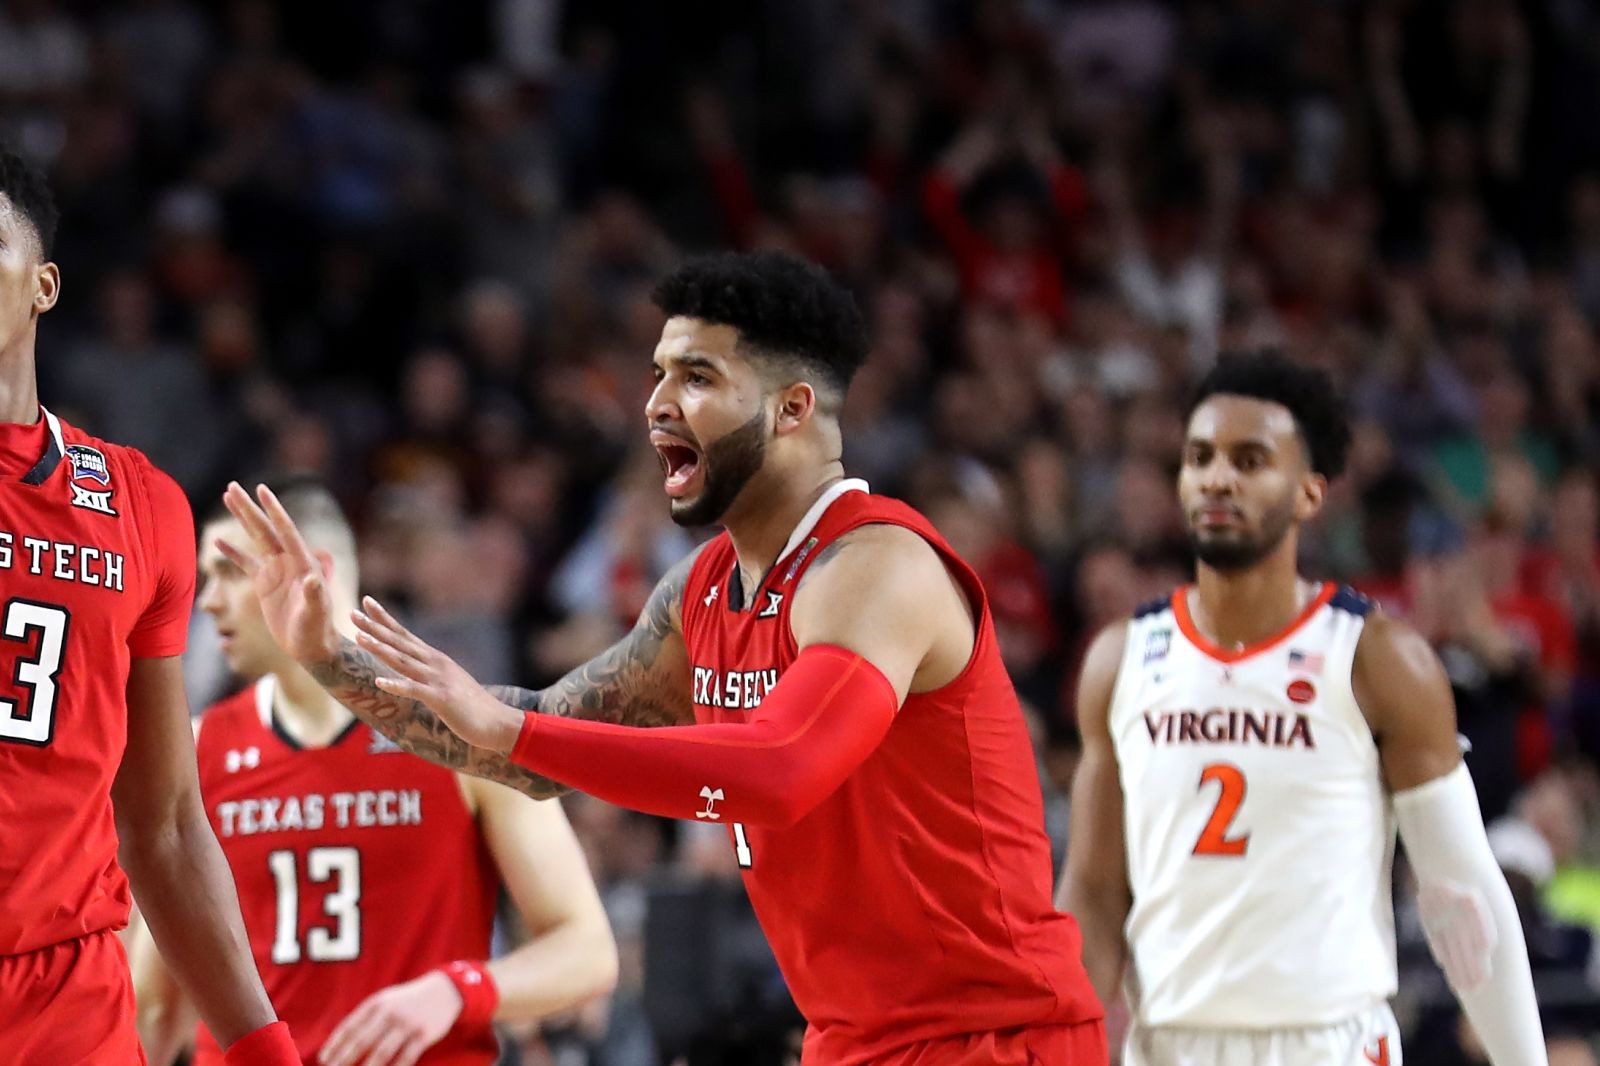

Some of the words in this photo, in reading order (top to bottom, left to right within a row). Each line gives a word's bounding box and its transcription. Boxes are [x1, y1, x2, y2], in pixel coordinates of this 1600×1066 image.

[75, 460, 104, 473] FOUR
[23, 535, 125, 592] TECH
[1143, 707, 1316, 750] VIRGINIA
[216, 793, 325, 838] TEXAS
[330, 788, 423, 828] TECH
[1191, 761, 1251, 857] 2
[267, 846, 362, 965] 13
